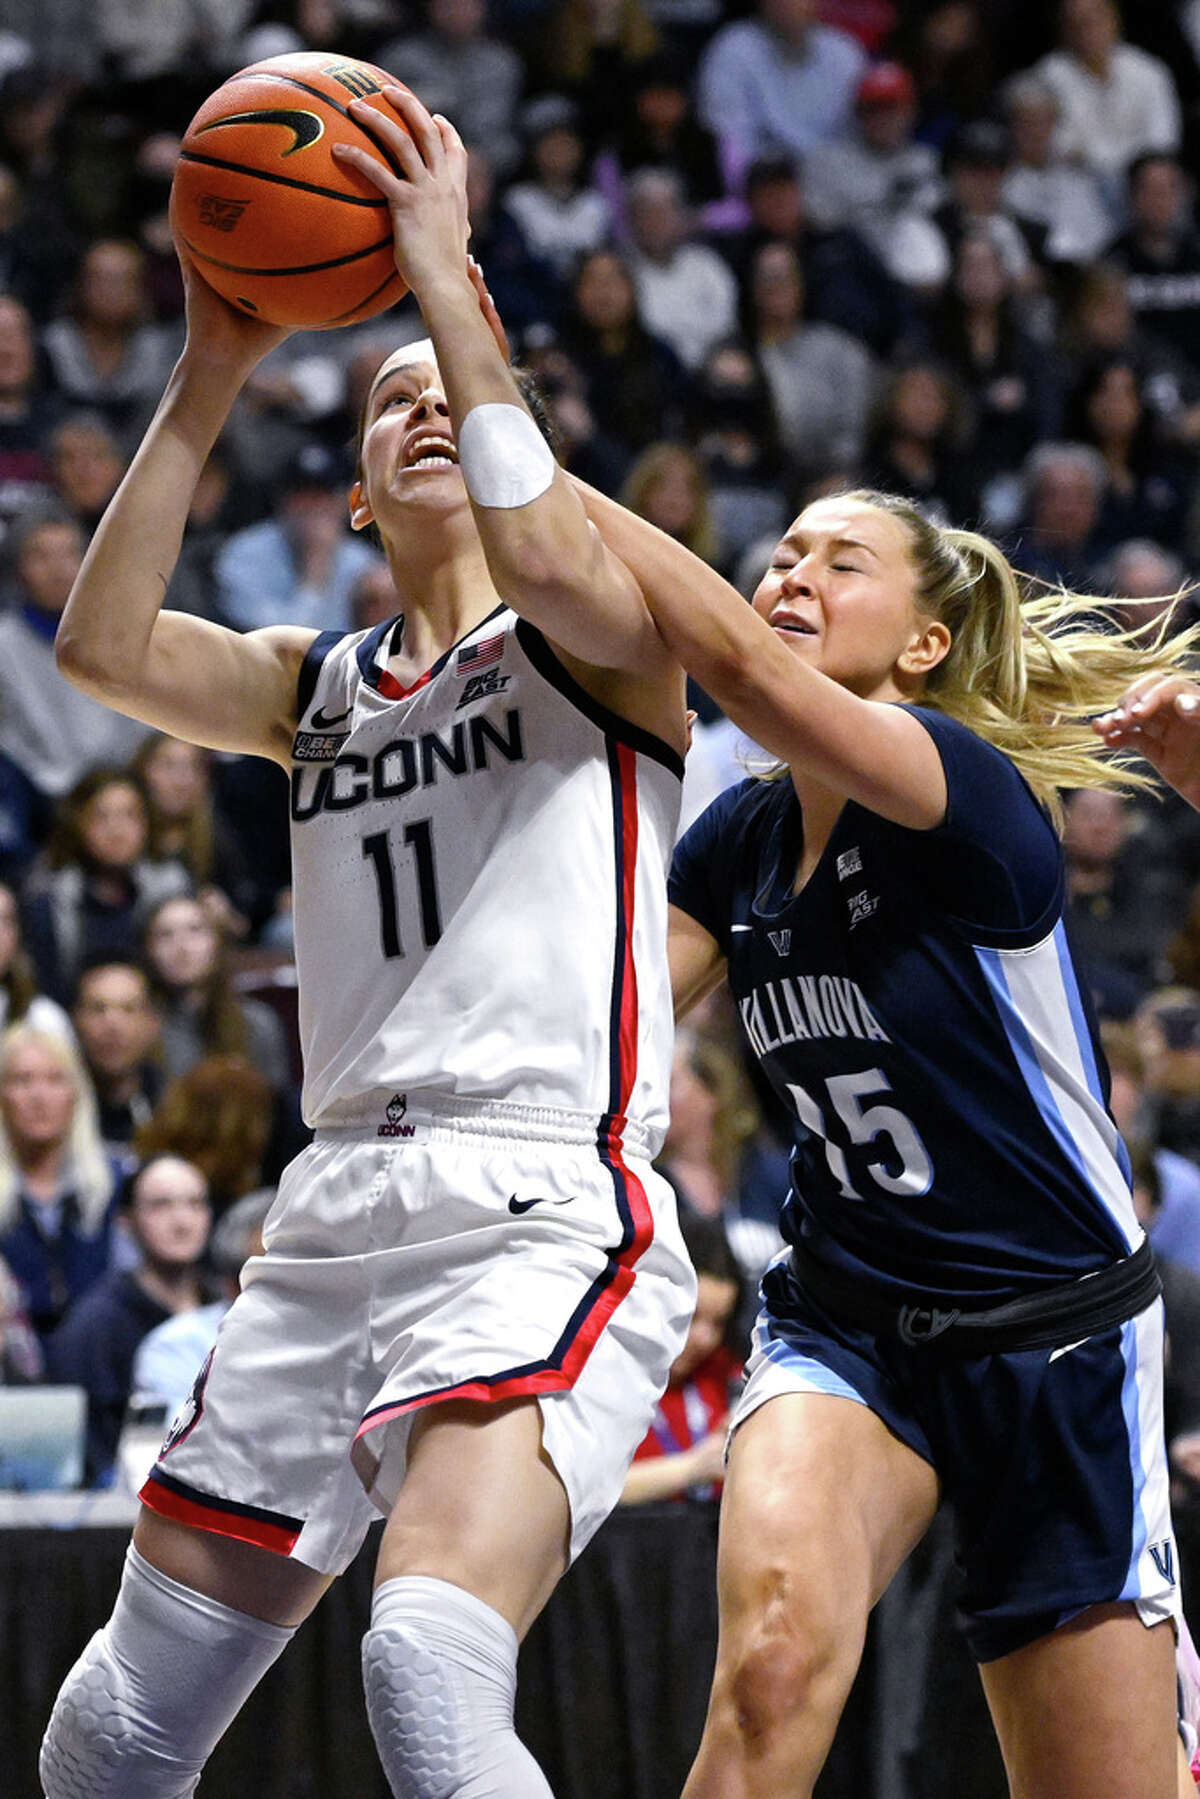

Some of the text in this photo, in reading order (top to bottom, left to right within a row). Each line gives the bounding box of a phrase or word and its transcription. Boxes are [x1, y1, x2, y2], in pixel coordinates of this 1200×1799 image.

[459, 675, 513, 704] EAST
[465, 667, 500, 692] BIG
[290, 708, 526, 823] UCONN
[295, 747, 336, 758] CHAN
[361, 816, 443, 960] 11
[850, 896, 880, 924] AST
[377, 1124, 416, 1137] UCONN
[785, 1067, 935, 1201] 15
